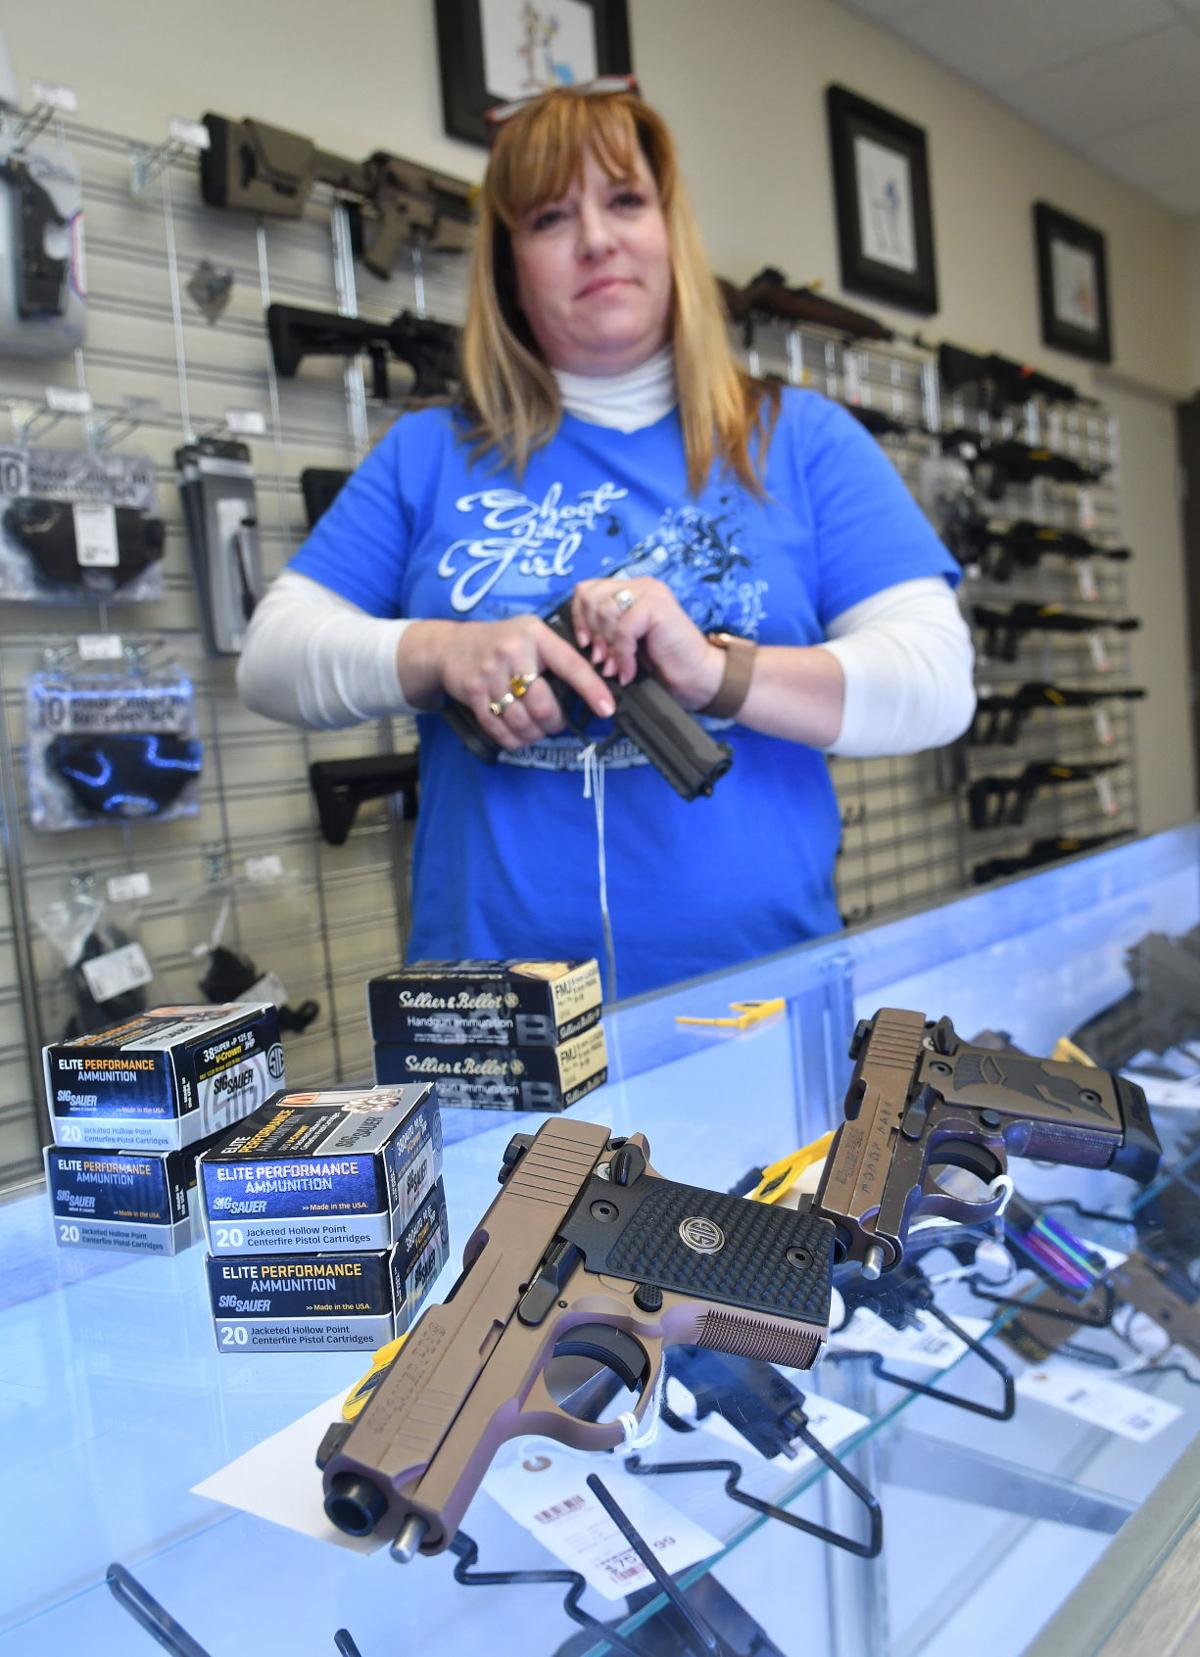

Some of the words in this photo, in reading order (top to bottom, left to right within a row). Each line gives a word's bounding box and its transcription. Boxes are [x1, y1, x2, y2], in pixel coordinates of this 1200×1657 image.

[438, 531, 582, 612] Girl
[399, 990, 446, 1009] Sellier
[456, 991, 503, 1009] Bellot
[407, 1015, 454, 1029] Handgun
[203, 1047, 216, 1063] 38
[213, 1040, 230, 1055] SUPER
[58, 1059, 84, 1070] ELITE
[84, 1059, 155, 1070] PERFORMANCE
[405, 1055, 451, 1073] Sellier
[462, 1058, 509, 1075] Bellot
[77, 1071, 137, 1082] AMMUNITION
[213, 1074, 228, 1095] SIG
[227, 1068, 254, 1094] SAUER
[57, 1089, 72, 1102] SIG
[70, 1095, 98, 1106] SAUER
[61, 1125, 82, 1142] 20
[221, 1136, 251, 1154] ELITE
[58, 1159, 82, 1171] ELITE
[83, 1161, 152, 1175] PERFORMANCE
[216, 1167, 254, 1181] ELITE
[255, 1162, 359, 1180] PERFORMANCE
[76, 1172, 134, 1185] AMMUNITION
[244, 1177, 333, 1194] AMMUNITION
[56, 1189, 70, 1202] SIG
[68, 1195, 96, 1208] SAUER
[212, 1197, 233, 1210] SIG
[230, 1200, 268, 1214] SAUER
[309, 1203, 329, 1211] Made
[338, 1202, 350, 1210] the
[60, 1225, 80, 1242] 20
[215, 1228, 244, 1248] 20
[246, 1228, 286, 1237] Jacketed
[288, 1226, 320, 1236] Hollow
[322, 1225, 347, 1234] Point
[247, 1237, 293, 1247] Centerfire
[295, 1235, 321, 1246] Pistol
[323, 1233, 371, 1245] Cartridges
[222, 1266, 259, 1279] ELITE
[261, 1263, 362, 1278] PERFORMANCE
[250, 1278, 337, 1293] AMMUNITION
[218, 1295, 237, 1308] SIG
[235, 1299, 271, 1312] SAUER
[220, 1326, 248, 1345] 20
[251, 1326, 290, 1335] Jacketed
[292, 1326, 323, 1334] Hollow
[326, 1325, 350, 1334] Point
[252, 1335, 297, 1345] Centerfire
[299, 1335, 324, 1344] Pistol
[327, 1335, 374, 1345] Cartridges
